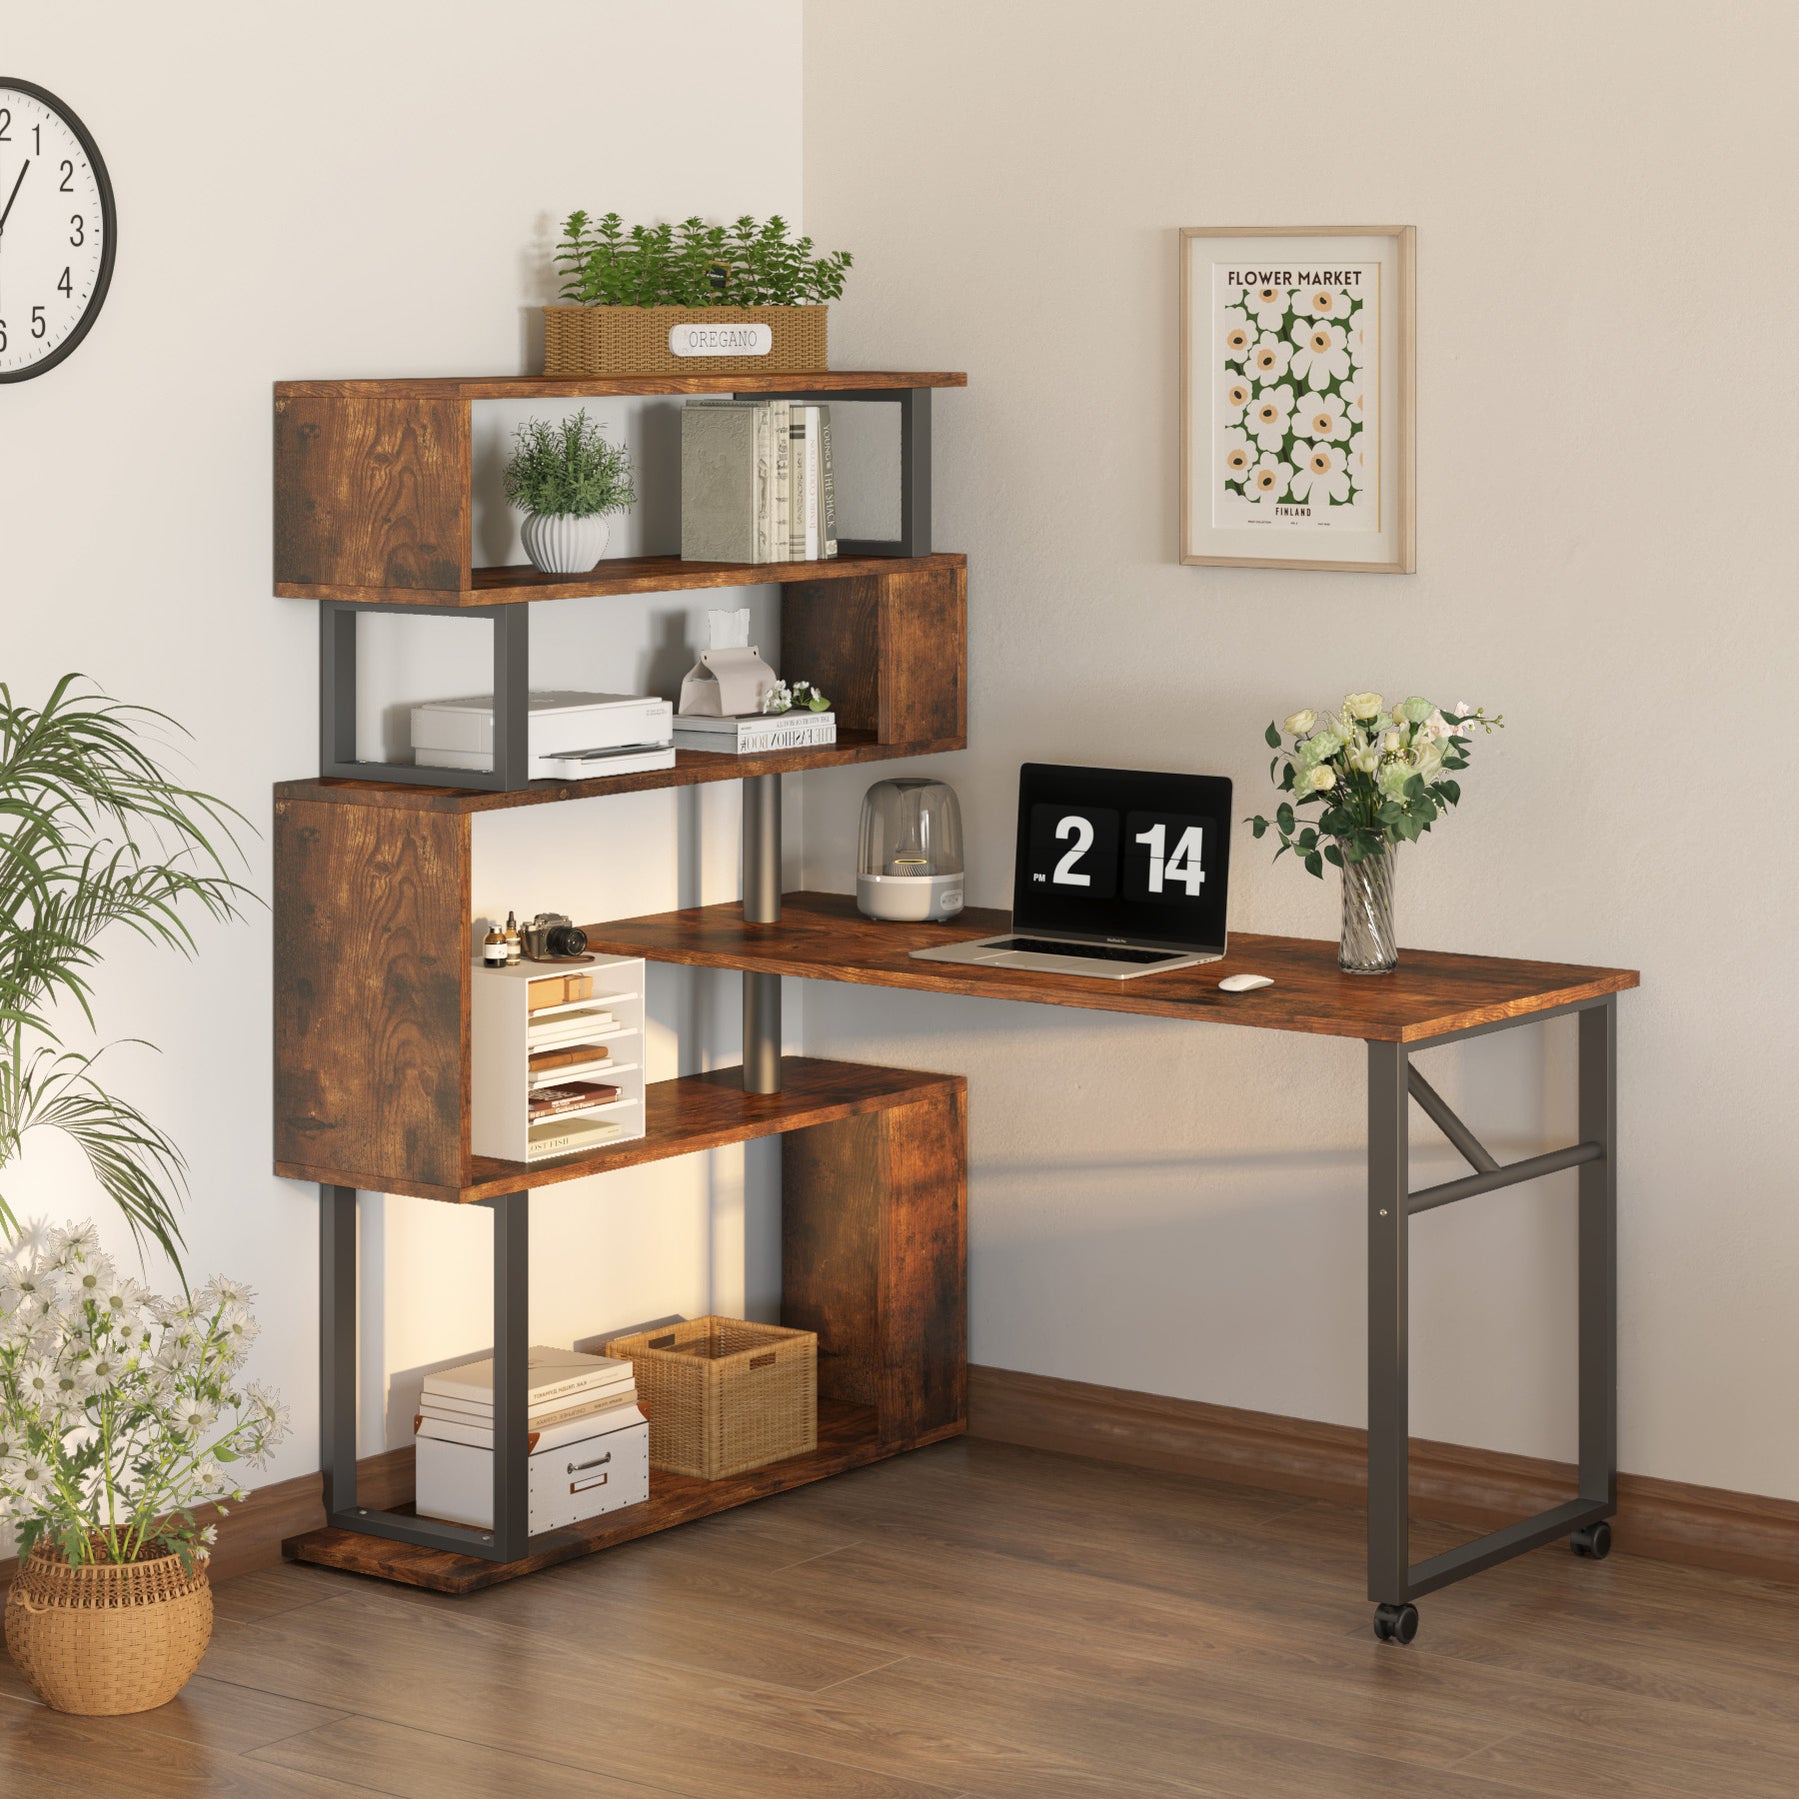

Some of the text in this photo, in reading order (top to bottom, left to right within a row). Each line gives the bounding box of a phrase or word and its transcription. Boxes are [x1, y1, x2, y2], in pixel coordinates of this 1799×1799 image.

[31, 123, 41, 156] 1
[59, 159, 75, 193] 2
[69, 214, 85, 247] 3
[57, 266, 73, 299] 4
[1228, 271, 1362, 286] FLOWER MARKET
[31, 306, 46, 339] 5
[688, 331, 758, 348] OREGANO
[823, 423, 836, 528] YOUNG THE SHACK
[1275, 506, 1312, 517] FINLAND
[1033, 815, 1206, 897] PM 2 14
[528, 1137, 569, 1152] OST FISH
